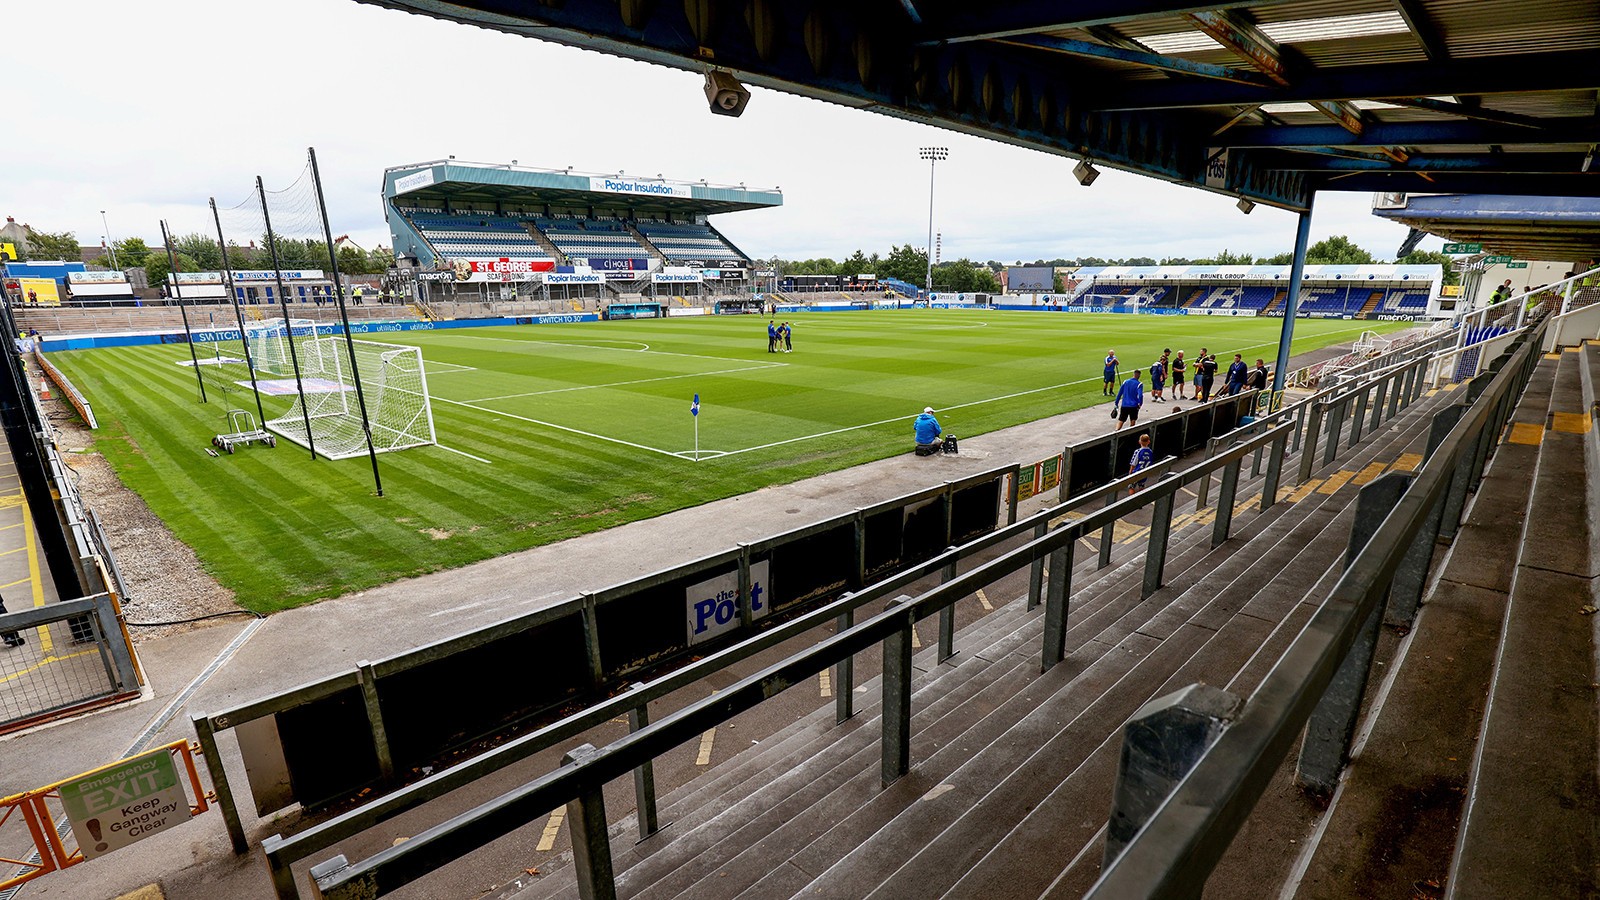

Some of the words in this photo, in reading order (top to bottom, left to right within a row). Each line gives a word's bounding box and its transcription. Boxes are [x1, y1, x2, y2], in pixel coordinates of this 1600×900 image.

[605, 180, 633, 192] Poplar
[634, 181, 673, 195] Insulation
[476, 262, 493, 272] ST.
[493, 262, 533, 272] GEORGE
[612, 260, 629, 268] HOLE
[419, 271, 453, 280] macron
[547, 274, 570, 283] Poplar
[570, 273, 600, 282] Insulation
[655, 274, 674, 282] Poplar
[538, 316, 562, 324] SWITCH
[1377, 313, 1414, 322] macron
[199, 331, 239, 342] SWITCH
[1019, 472, 1032, 484] EXIT
[716, 590, 734, 601] the
[78, 759, 157, 793] Emergency
[84, 769, 161, 814] EXIT
[121, 798, 160, 818] Keep
[110, 801, 178, 832] Gangway
[129, 816, 167, 838] Clear
